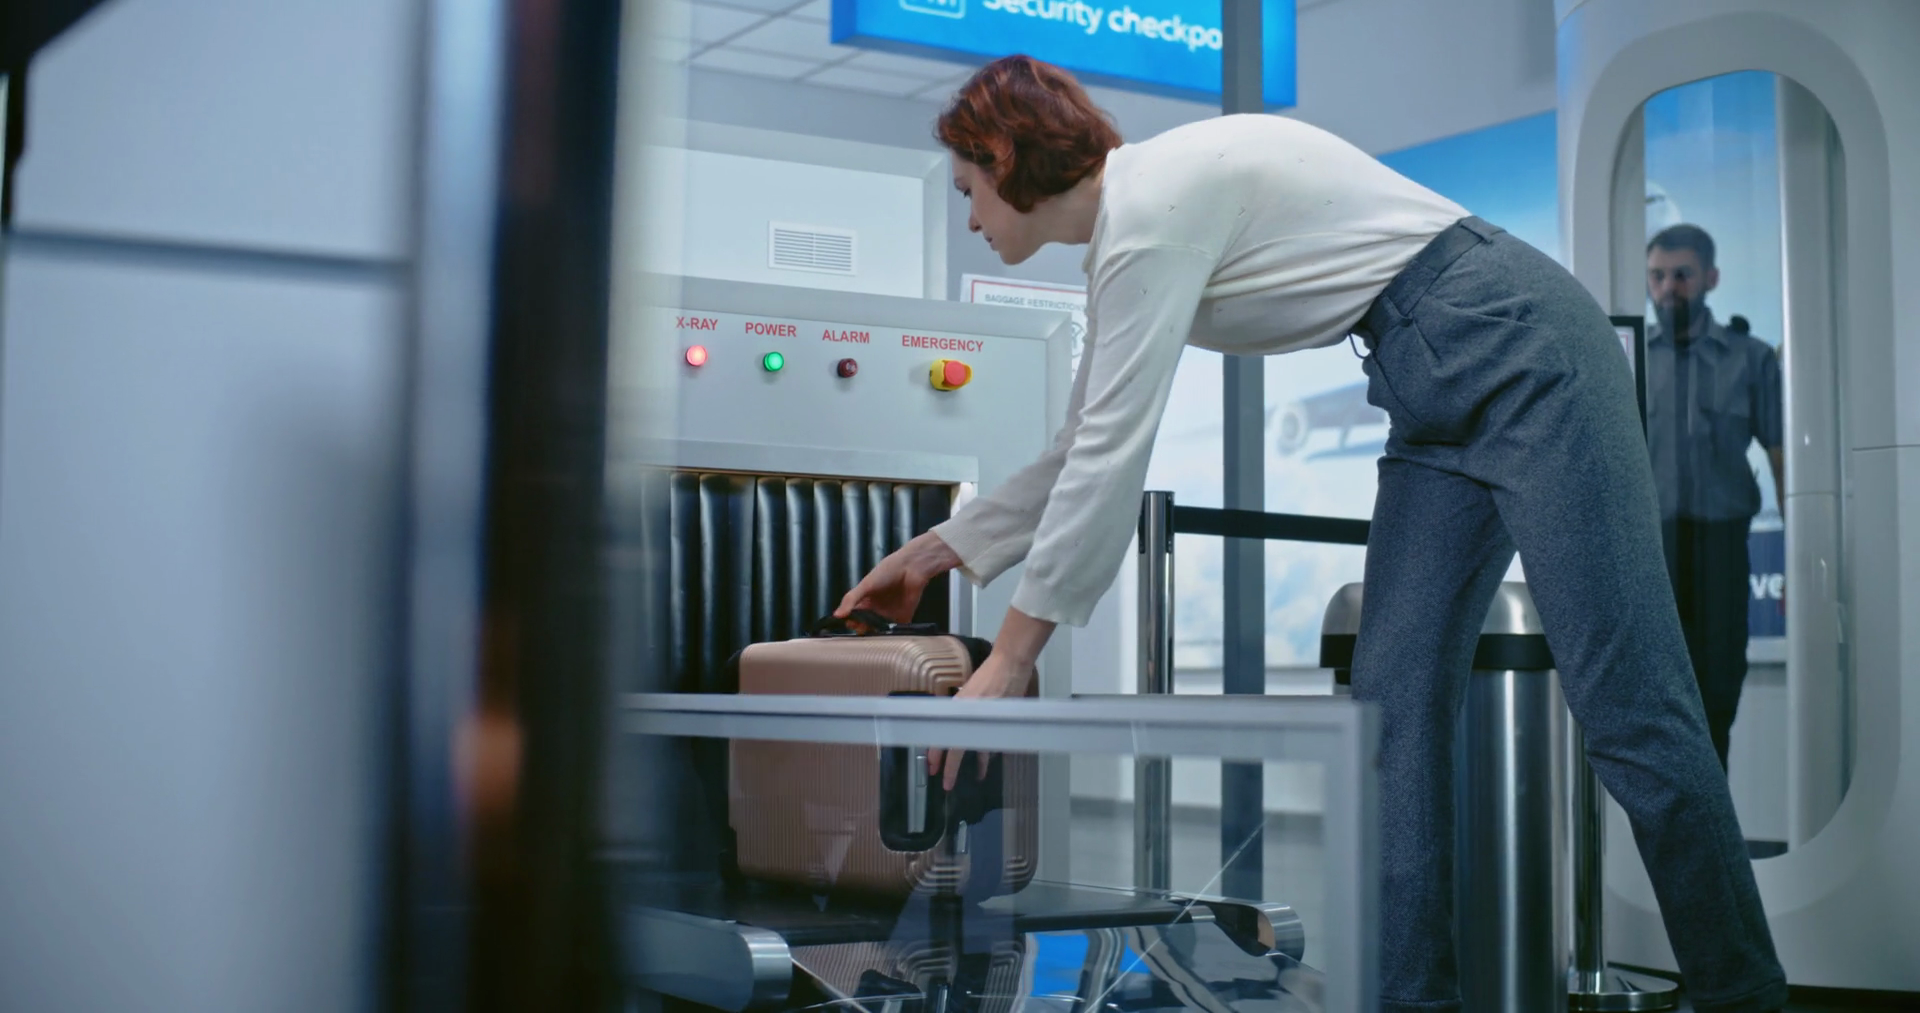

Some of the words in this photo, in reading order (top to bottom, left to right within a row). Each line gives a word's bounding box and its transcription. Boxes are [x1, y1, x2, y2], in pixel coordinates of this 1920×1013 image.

[985, 294, 1025, 306] BAGGAGE
[676, 316, 718, 331] X-RAY
[745, 322, 797, 337] POWER
[822, 329, 870, 344] ALARM
[902, 335, 984, 352] EMERGENCY
